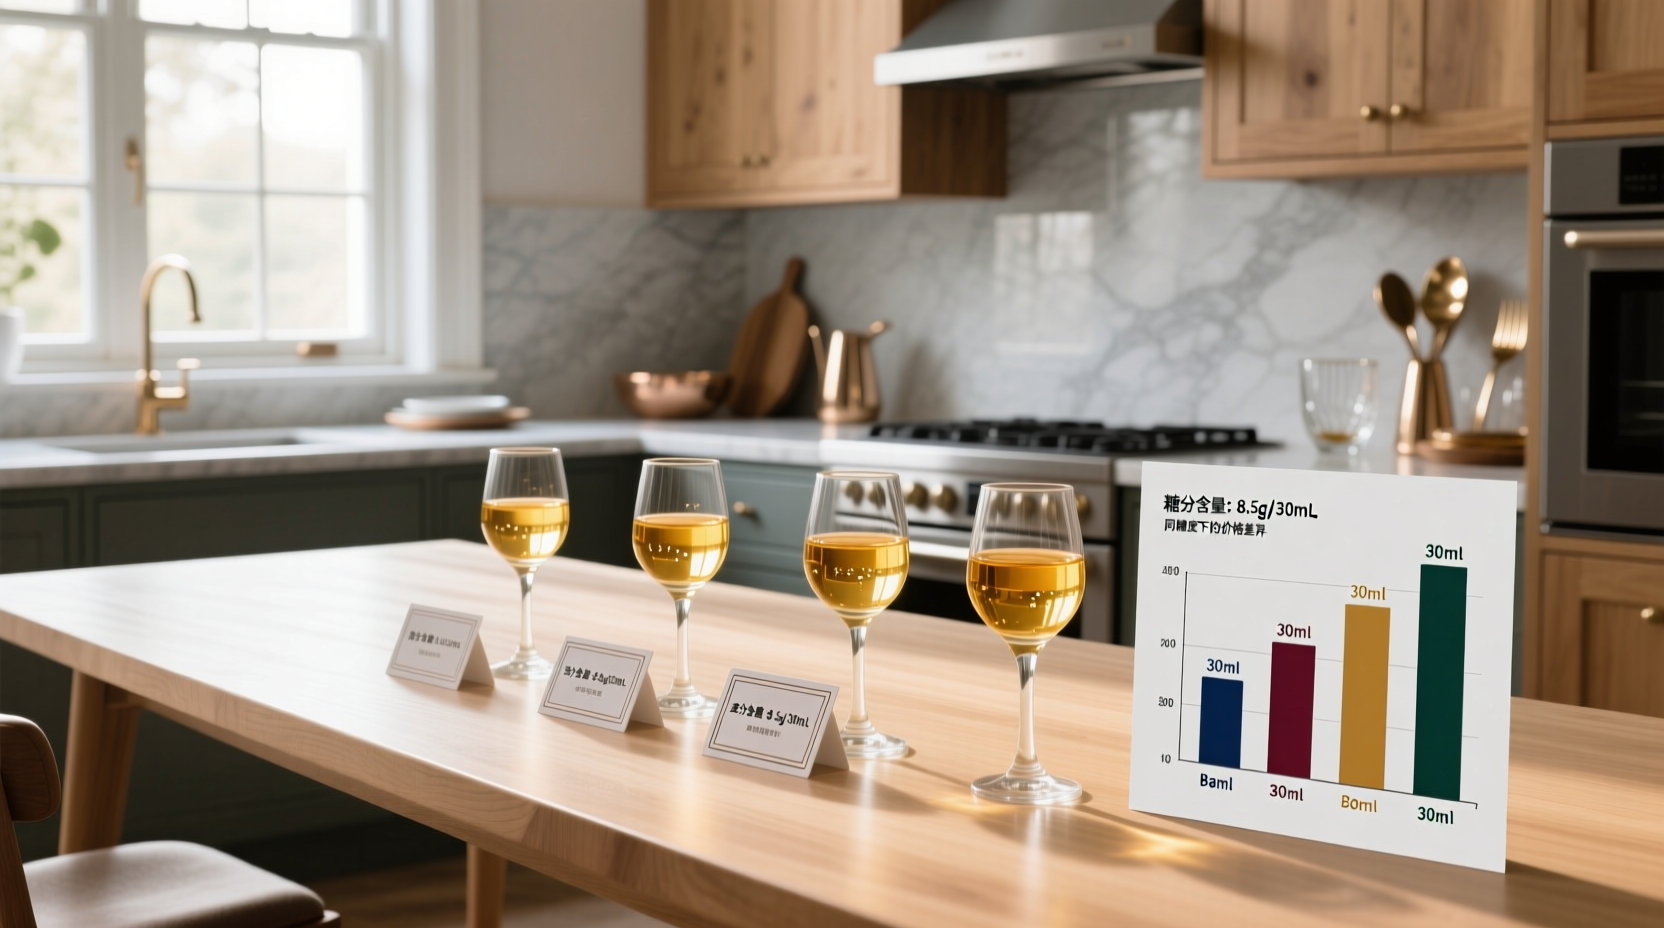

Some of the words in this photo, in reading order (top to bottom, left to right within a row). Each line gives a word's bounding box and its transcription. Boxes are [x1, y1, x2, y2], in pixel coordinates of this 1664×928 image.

[1237, 499, 1318, 520] 8.5g/30mL
[1426, 544, 1463, 560] 30ml
[1351, 585, 1385, 600] 30ml
[1277, 623, 1311, 639] 30ml
[1207, 658, 1239, 674] 30ml
[1161, 754, 1171, 764] 10
[1200, 773, 1232, 791] Baml
[1270, 784, 1303, 801] 30ml
[1418, 806, 1453, 824] 30ml
